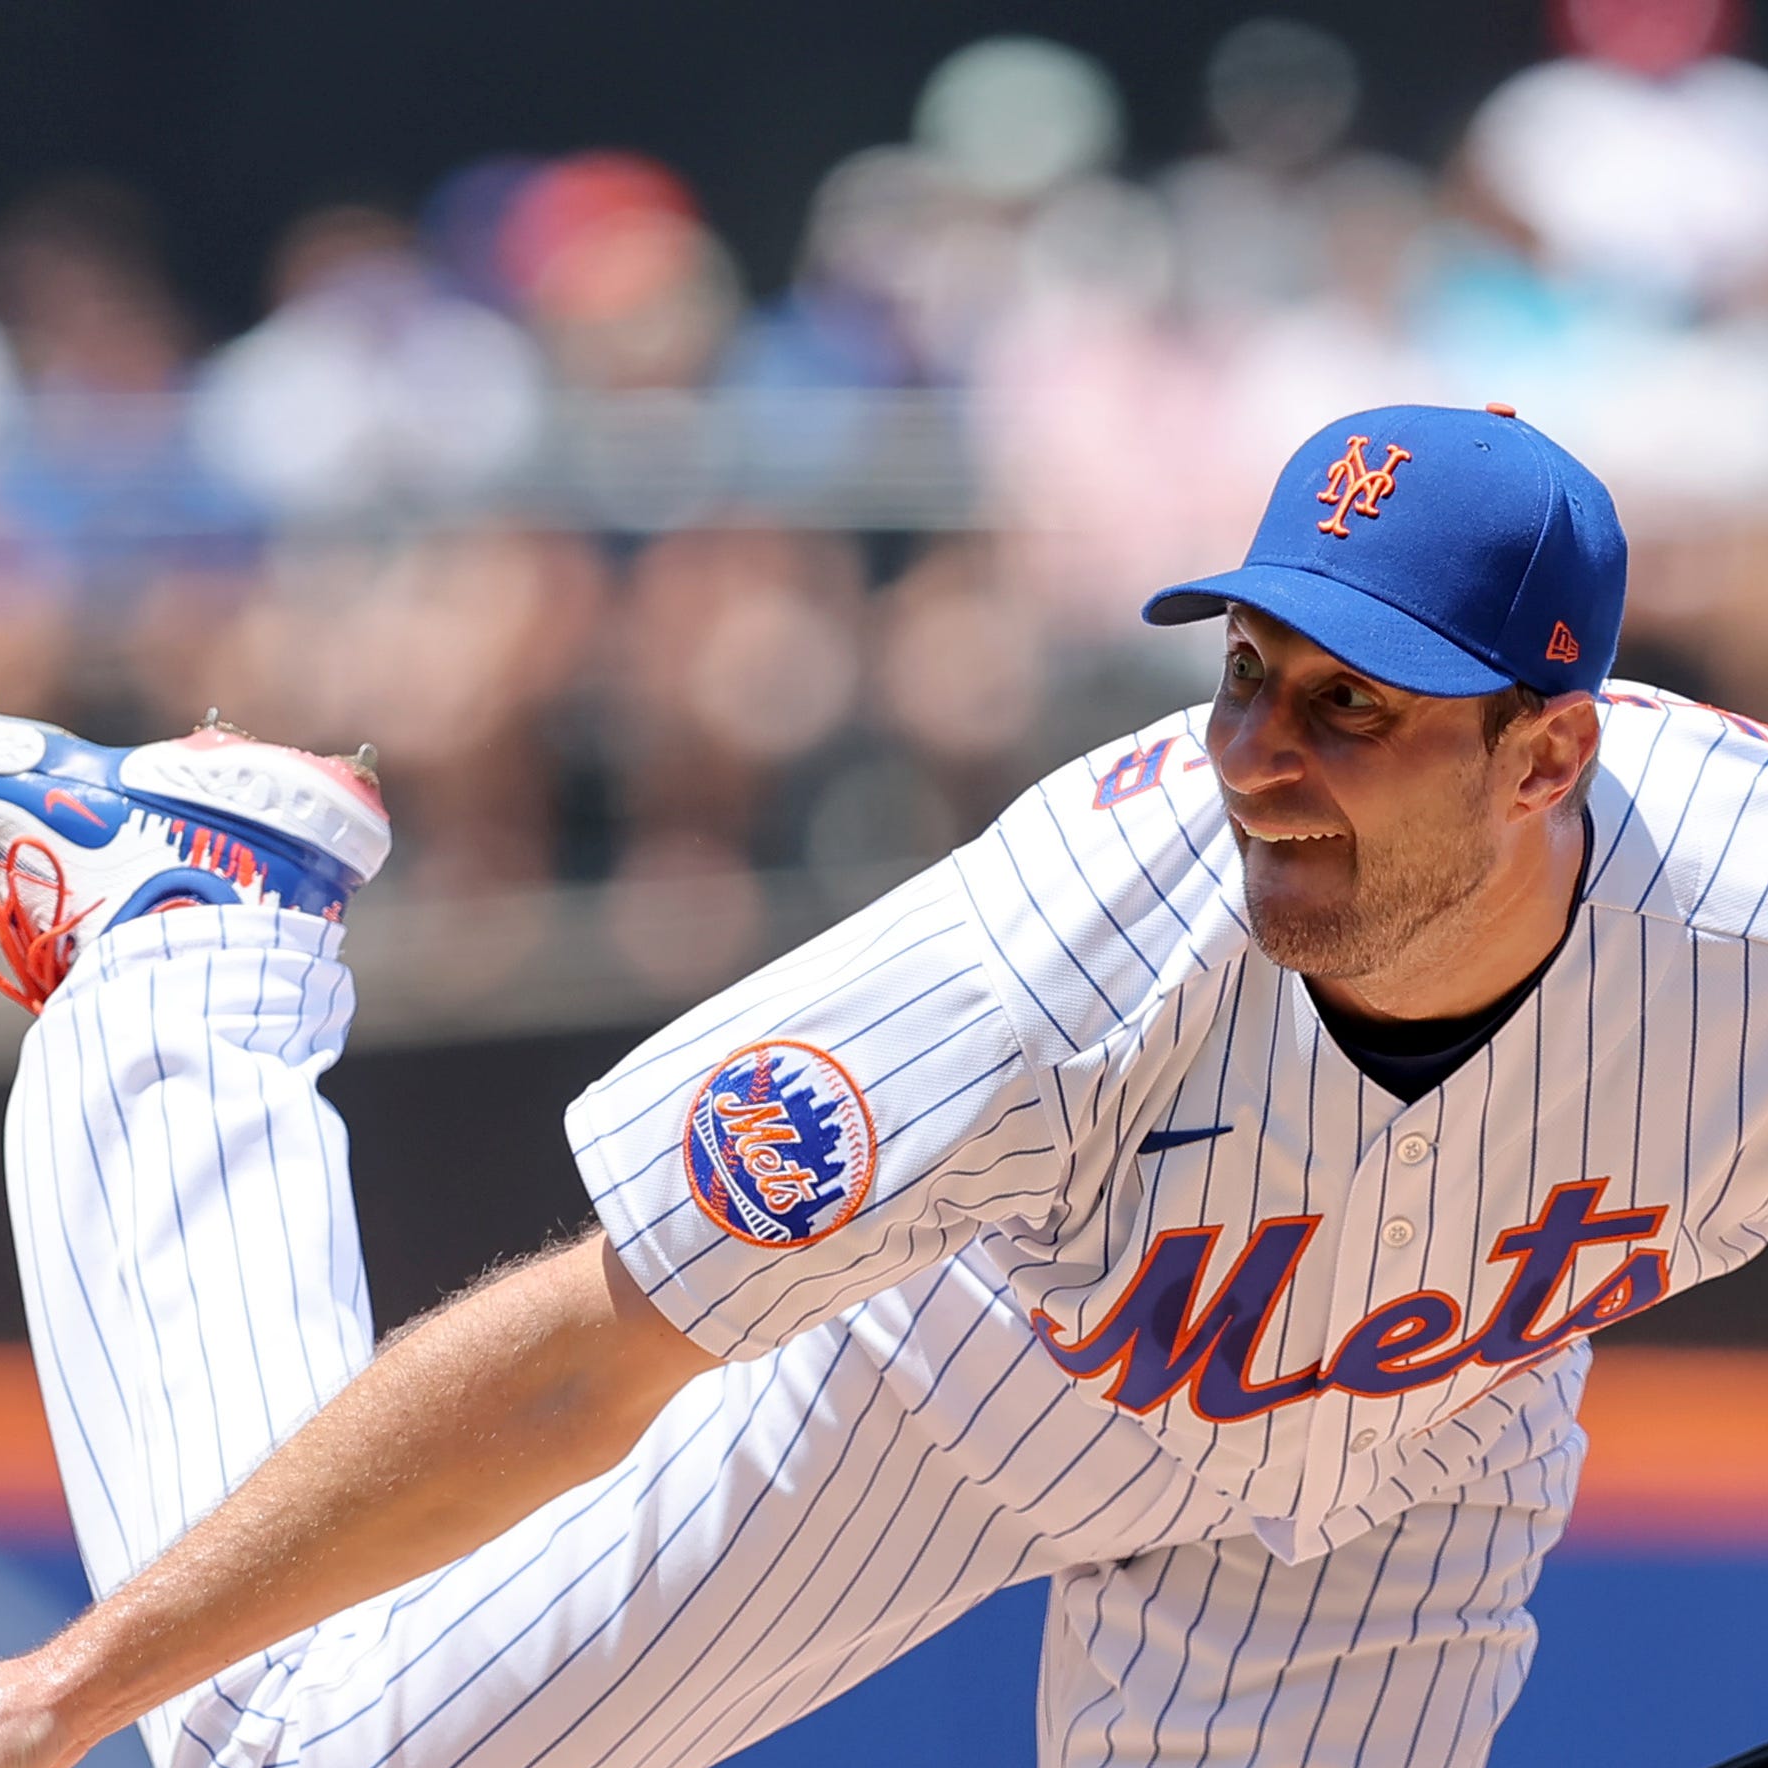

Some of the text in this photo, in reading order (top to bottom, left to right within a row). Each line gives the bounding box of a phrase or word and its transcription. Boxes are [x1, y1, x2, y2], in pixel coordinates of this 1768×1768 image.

[1317, 435, 1412, 538] NY
[713, 1091, 818, 1215] Mets
[1033, 1176, 1670, 1424] Mets
